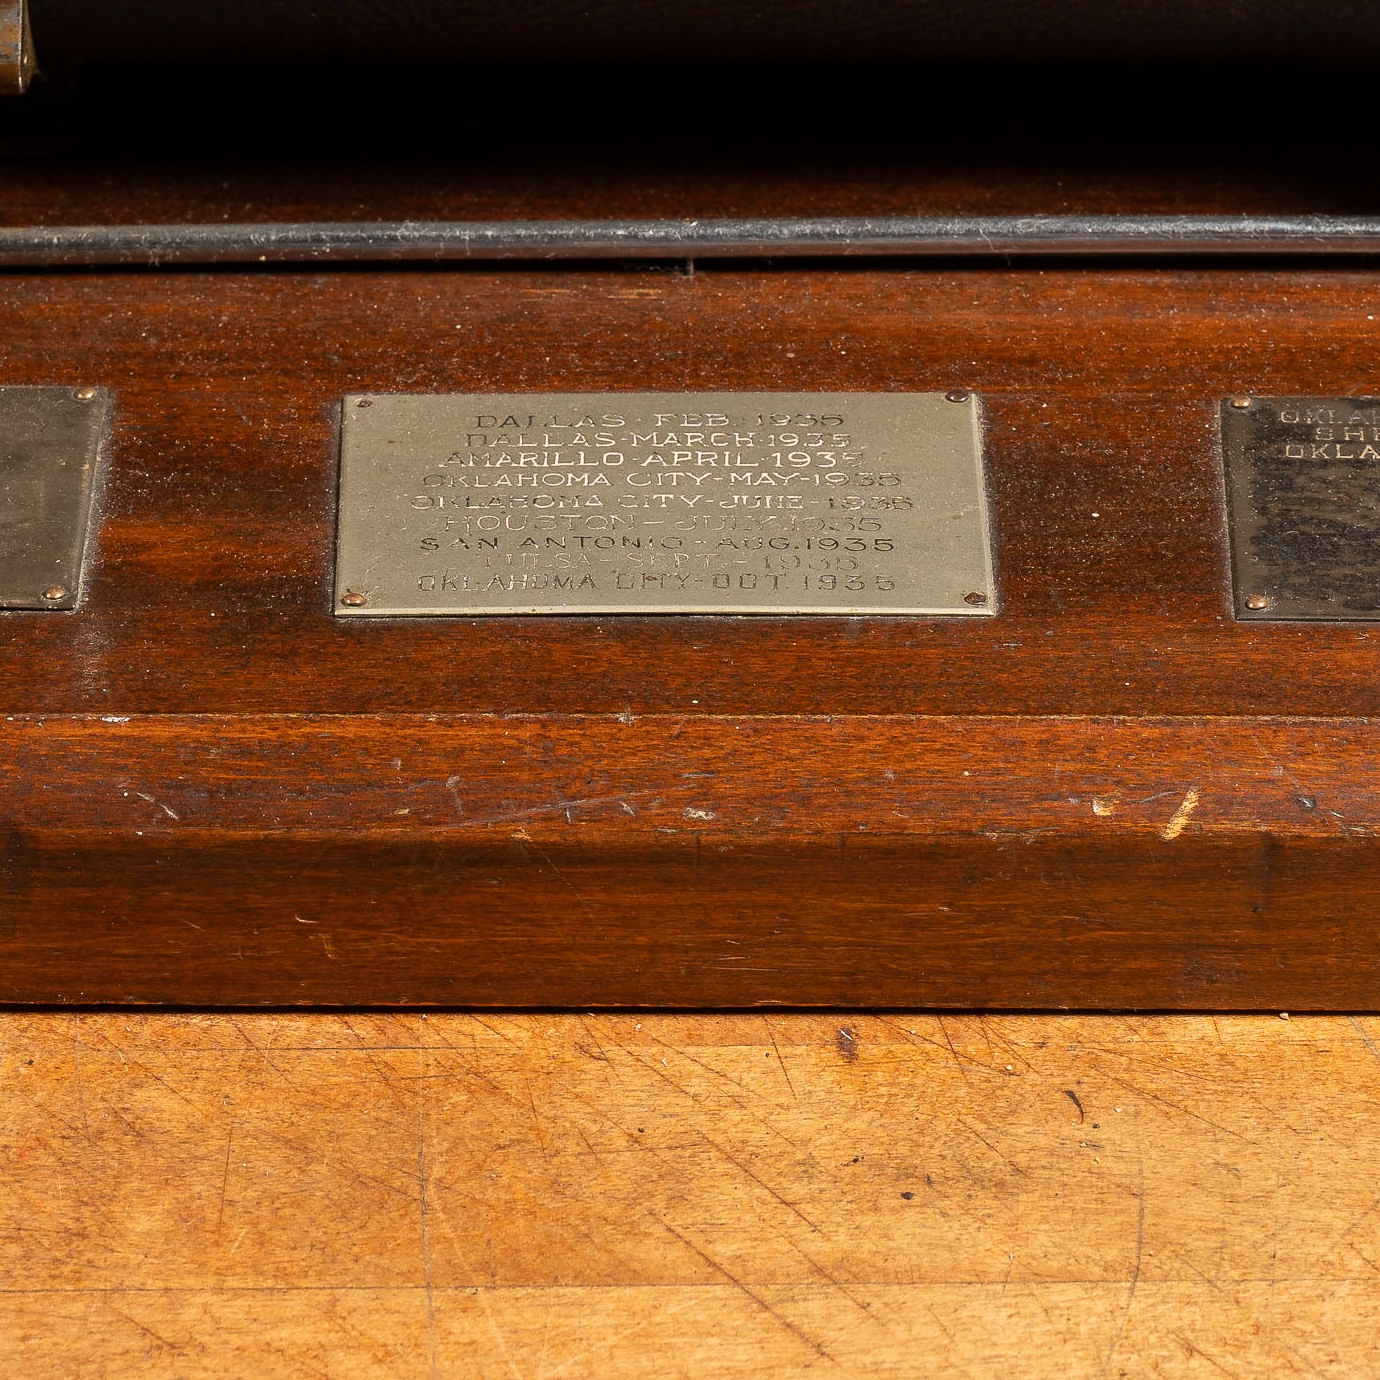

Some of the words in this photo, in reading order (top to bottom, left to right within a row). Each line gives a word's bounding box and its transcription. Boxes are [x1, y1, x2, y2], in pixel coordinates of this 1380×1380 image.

[475, 413, 626, 429] DALLAS
[756, 413, 845, 428] 1935
[421, 472, 615, 489] OKLAHOMA
[410, 493, 605, 510] OKLAHOMA
[443, 514, 636, 532] HOUSTON
[674, 514, 778, 532] JULY
[419, 535, 500, 552] SAN
[517, 535, 683, 551] ANTONIO
[478, 552, 592, 569] TULSA
[763, 554, 860, 571] 1935
[416, 572, 597, 592] OKLAHOMA
[803, 573, 897, 592] 1935
